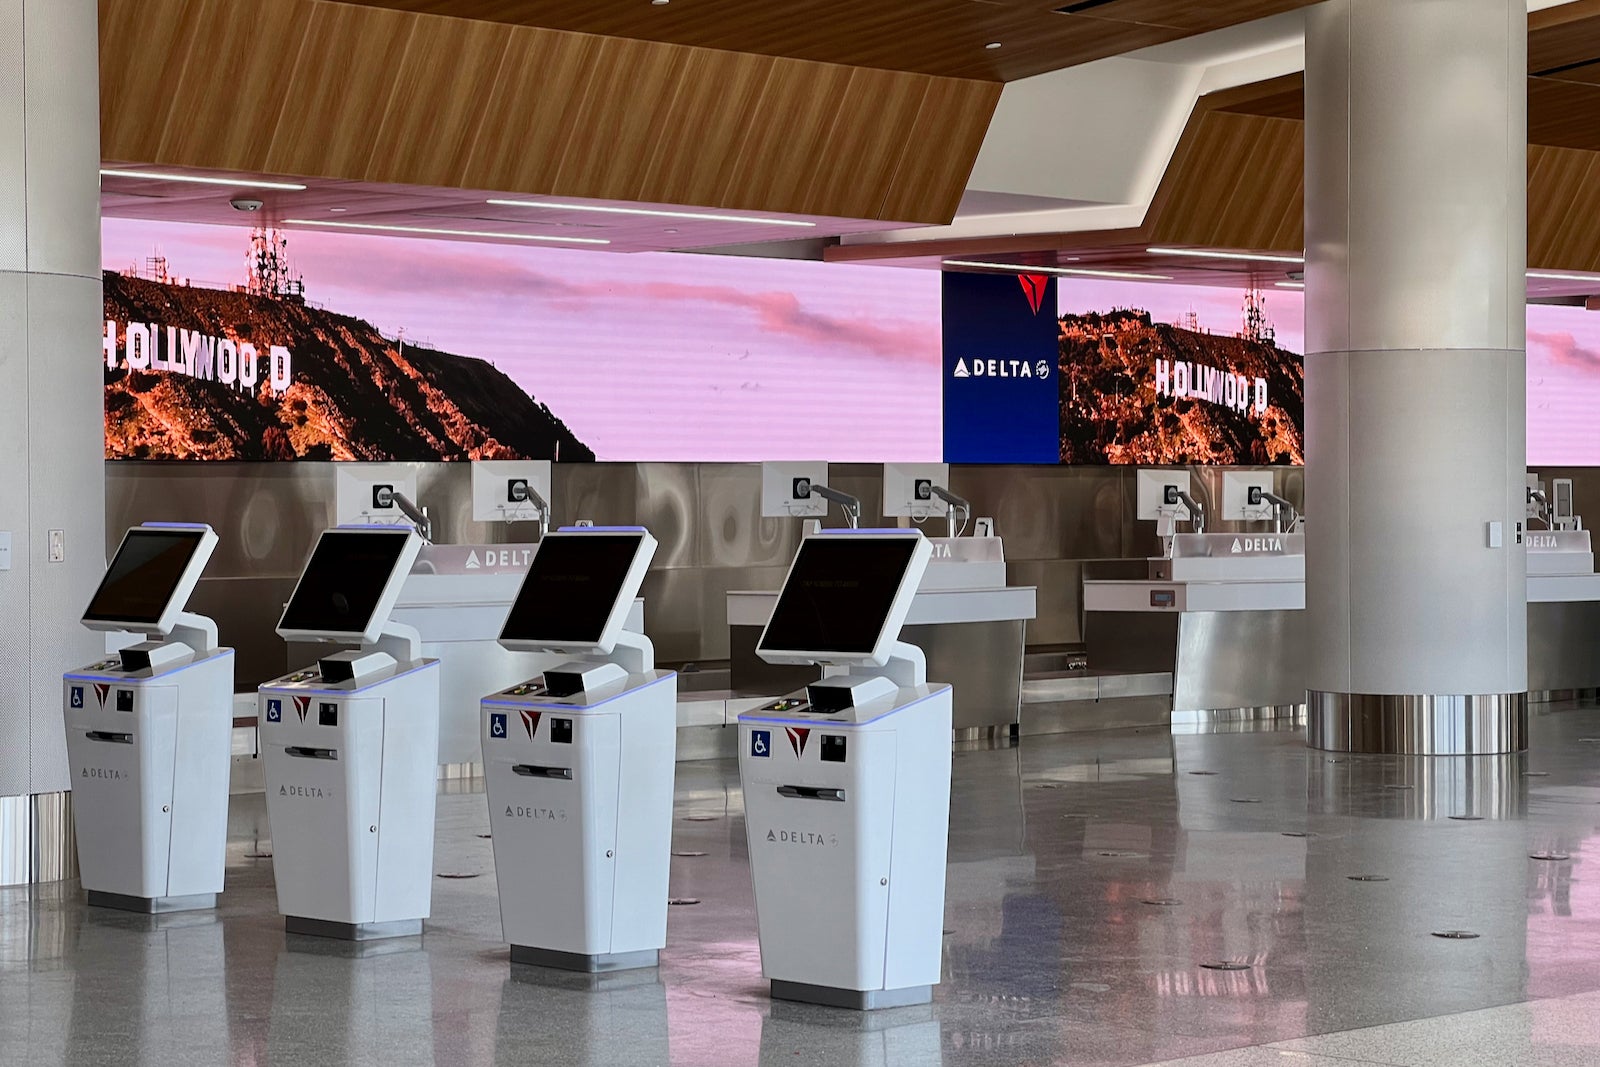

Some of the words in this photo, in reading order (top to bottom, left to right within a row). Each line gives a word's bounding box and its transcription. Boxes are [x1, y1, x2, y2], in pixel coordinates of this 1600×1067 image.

[103, 320, 291, 391] HOLLYWOOD
[973, 358, 1032, 378] DELTA
[1155, 358, 1268, 413] HOLLYWOOD
[1244, 538, 1282, 552] DELTA
[1525, 535, 1558, 548] DELTA
[485, 550, 531, 567] DELT
[90, 768, 121, 780] DELTA
[290, 786, 324, 799] DELTA
[516, 806, 556, 821] DELTA
[780, 830, 825, 846] DELTA
